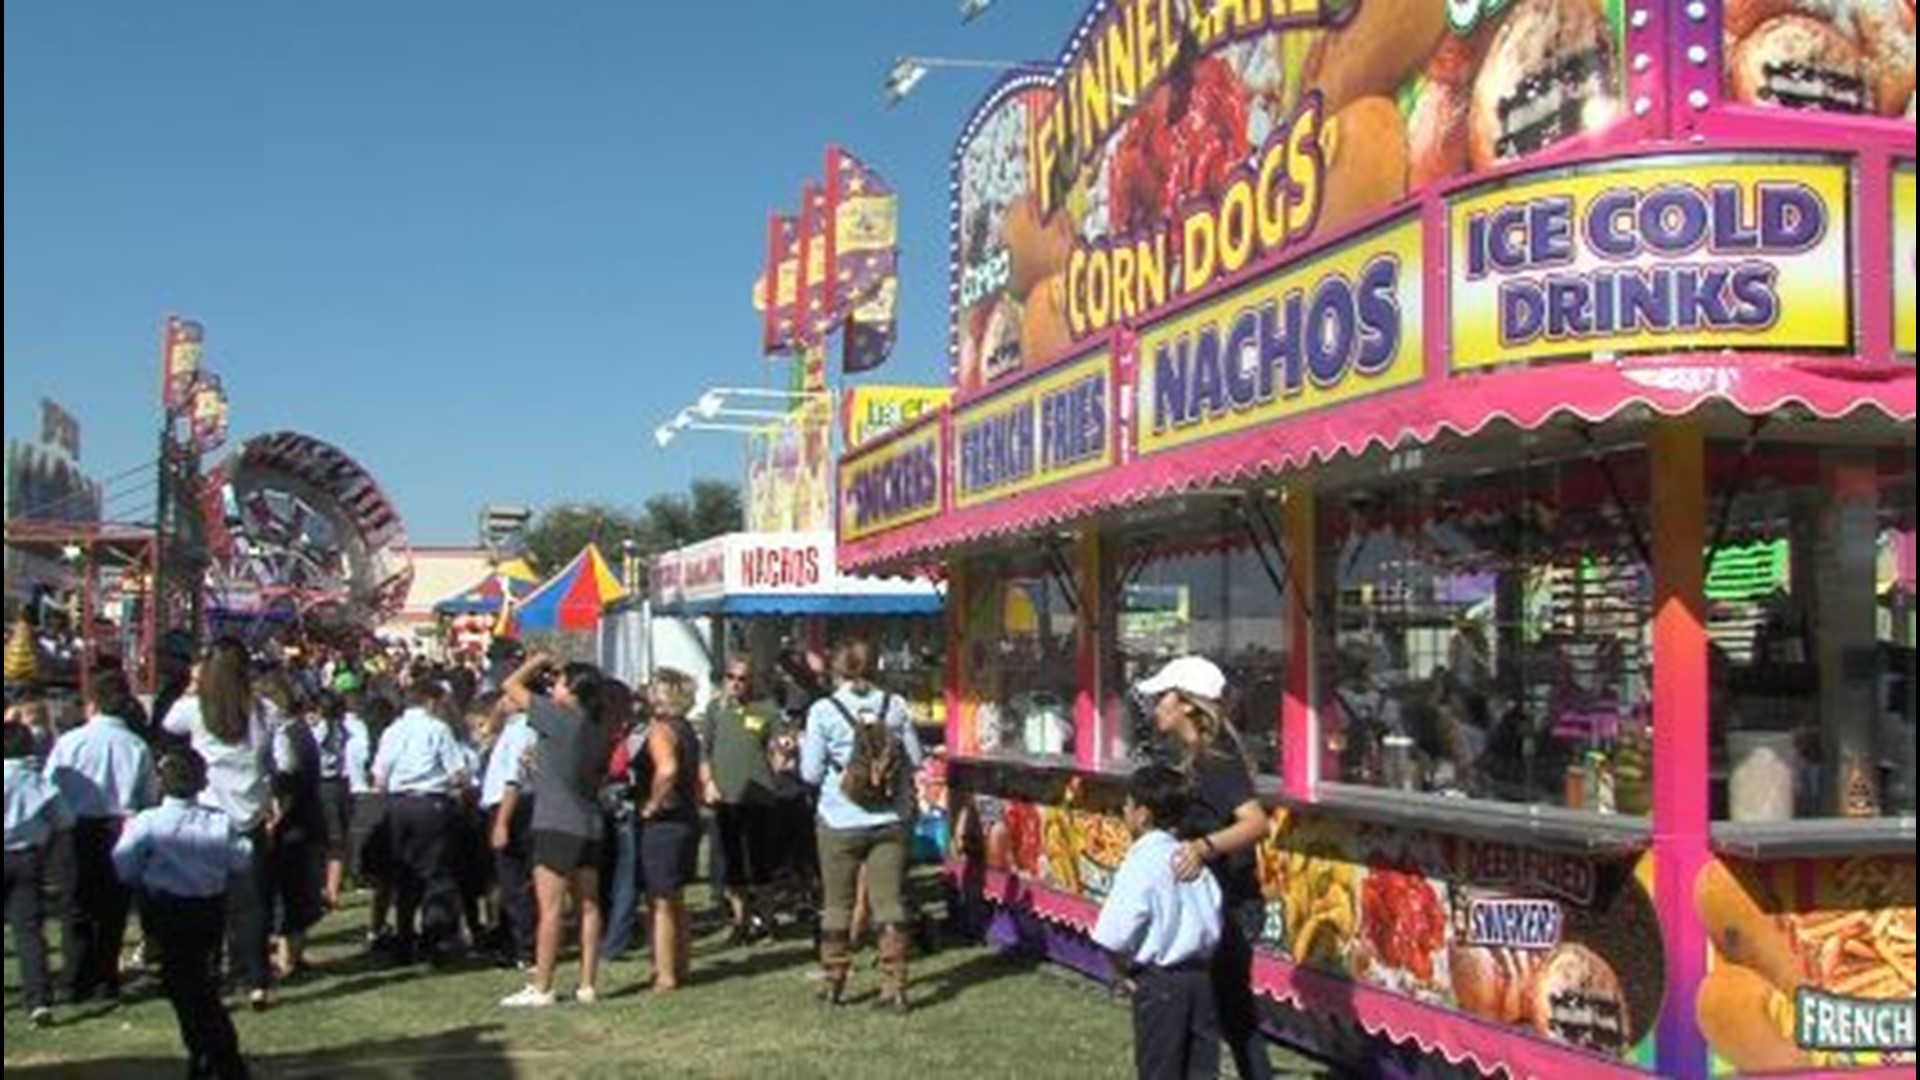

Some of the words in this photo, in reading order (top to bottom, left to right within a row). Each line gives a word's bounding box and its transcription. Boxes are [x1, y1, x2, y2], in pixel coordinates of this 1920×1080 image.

[1069, 236, 1167, 333] CORN
[1184, 110, 1316, 295] DOGS
[1466, 196, 1575, 280] ICE
[1586, 180, 1826, 257] COLD
[1152, 252, 1401, 435] NACHOS
[1500, 261, 1779, 346] DRINKS
[962, 400, 1035, 496] FRENCH
[1041, 373, 1106, 468] FRIES
[741, 546, 819, 588] NACHOS
[1472, 903, 1561, 943] SNICKERS
[1802, 994, 1914, 1044] FRENCH
